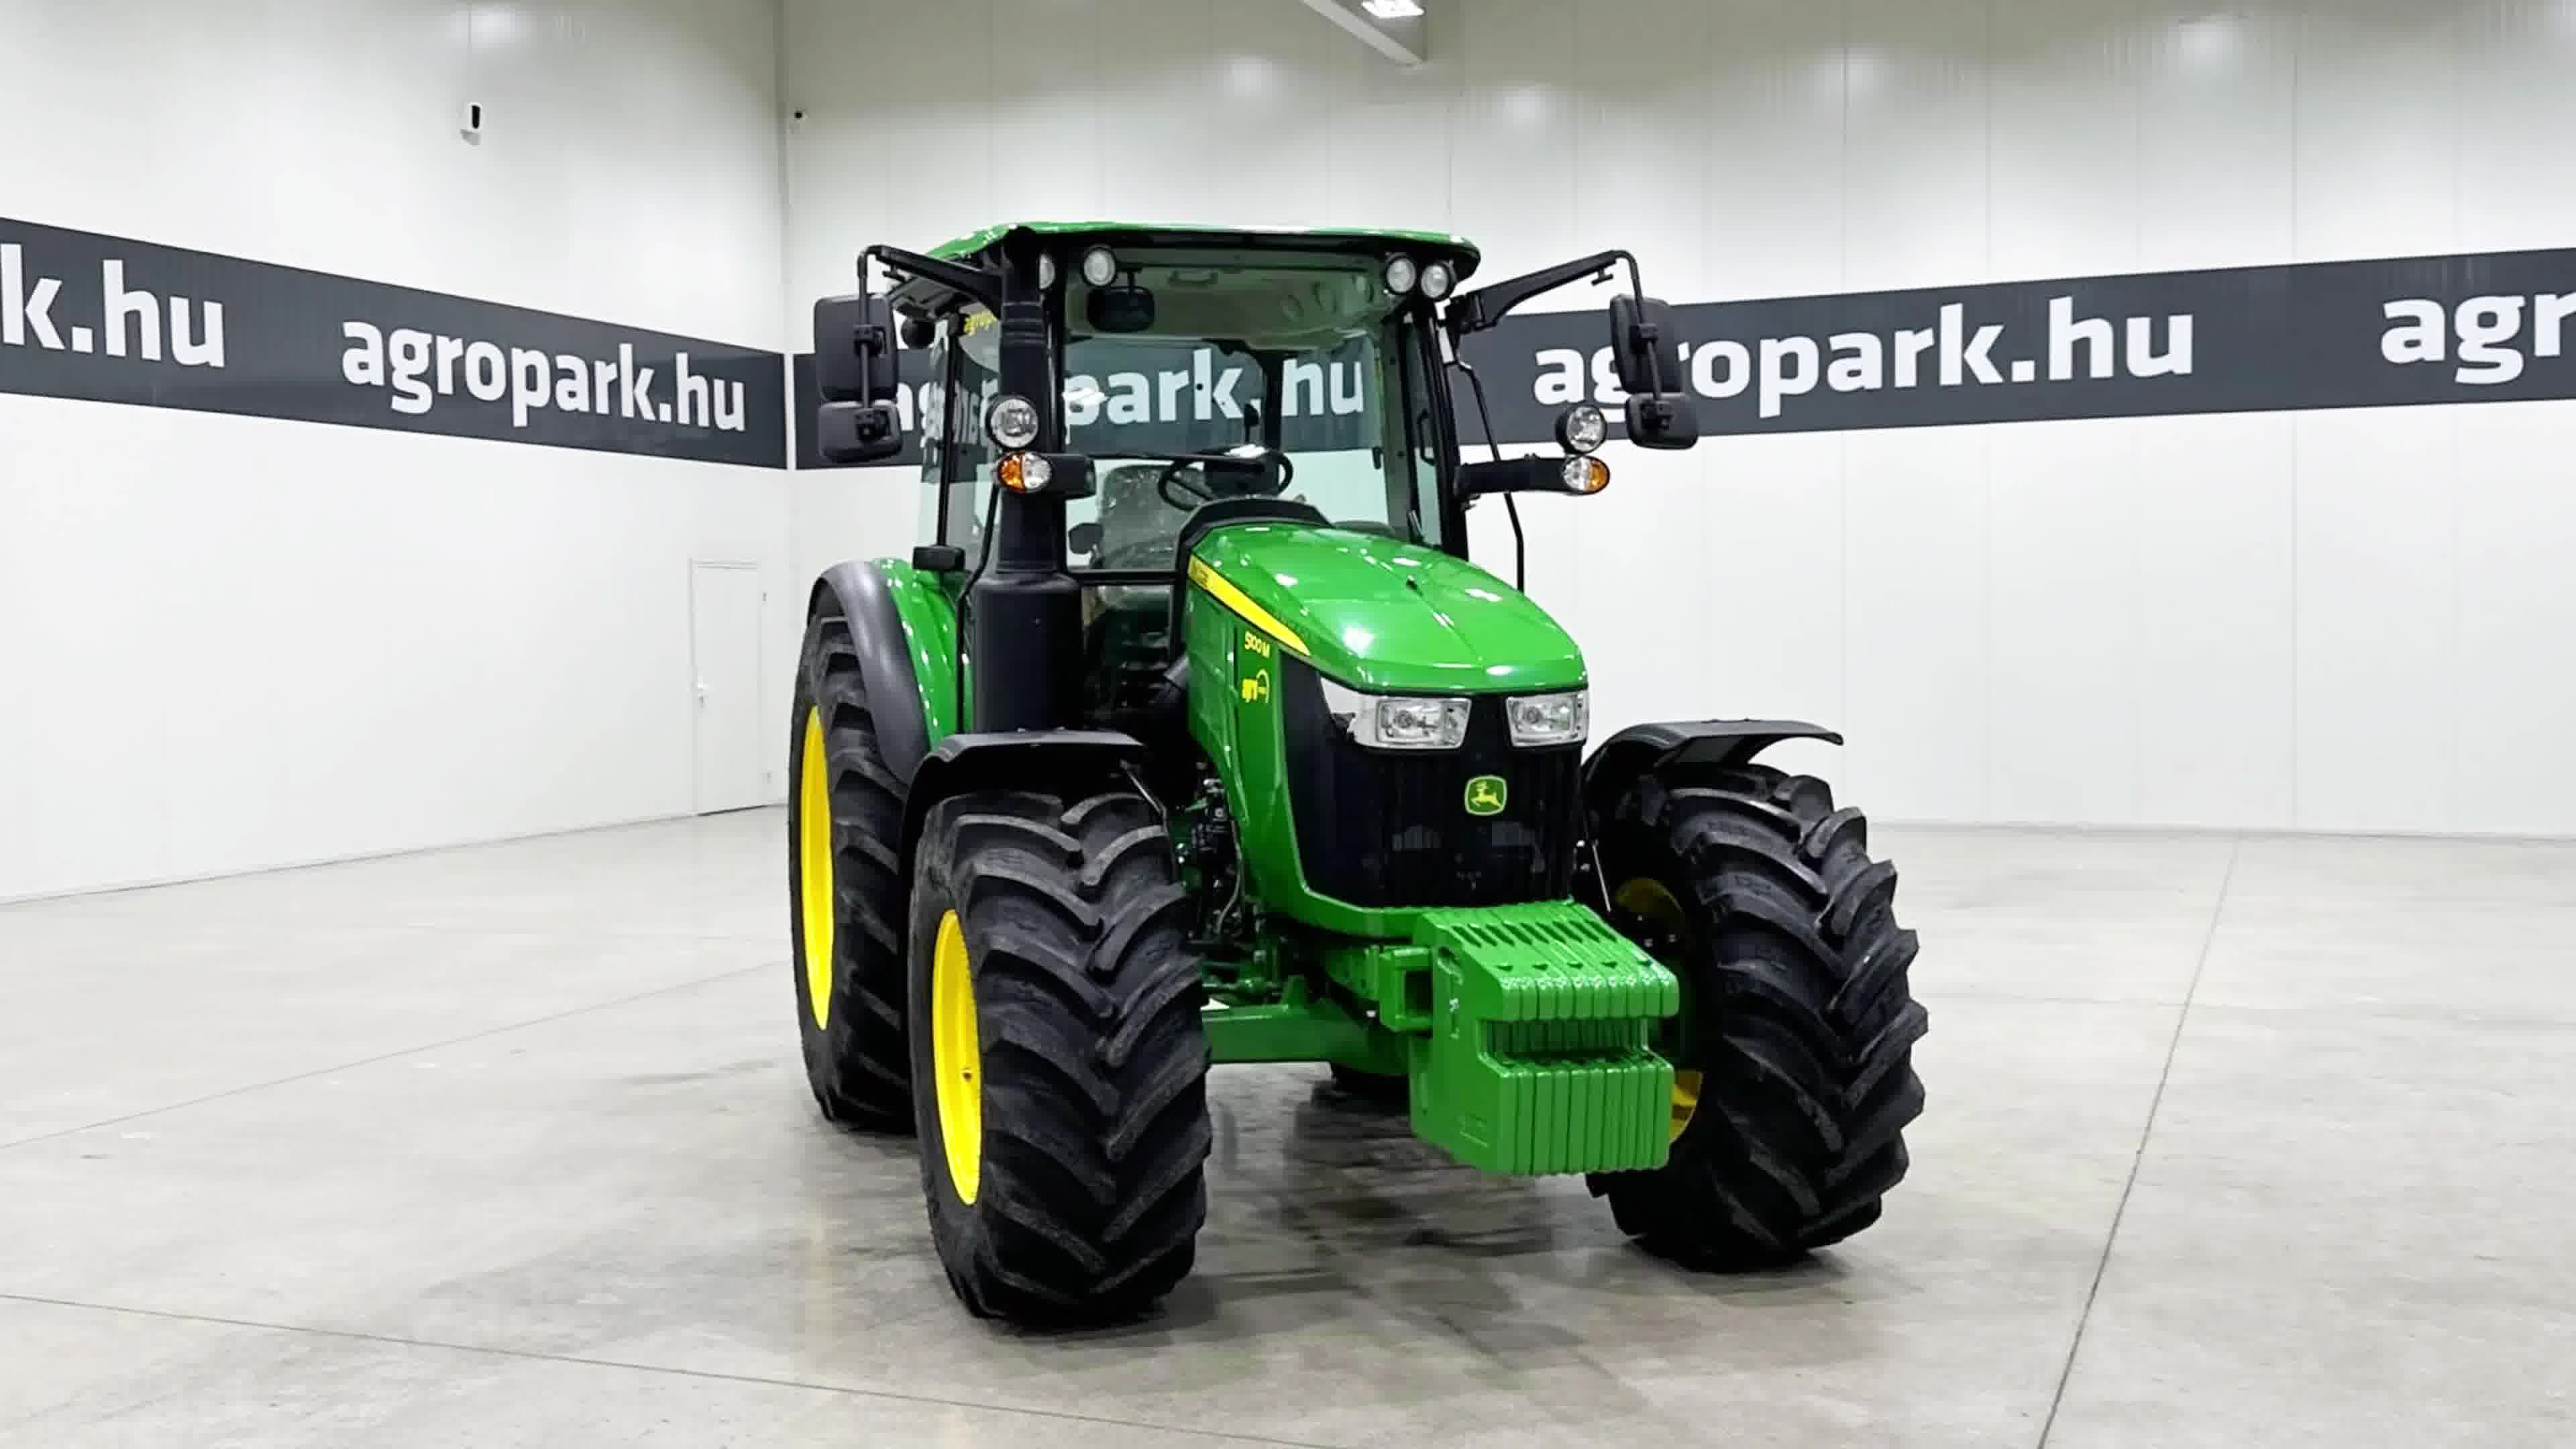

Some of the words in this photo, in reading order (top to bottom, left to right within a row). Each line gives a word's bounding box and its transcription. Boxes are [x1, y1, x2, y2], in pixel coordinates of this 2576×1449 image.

[0, 244, 225, 368] k.hu
[1534, 295, 2194, 424] agopark.hu
[2381, 291, 2576, 385] agr
[342, 321, 745, 433] agropark.hu
